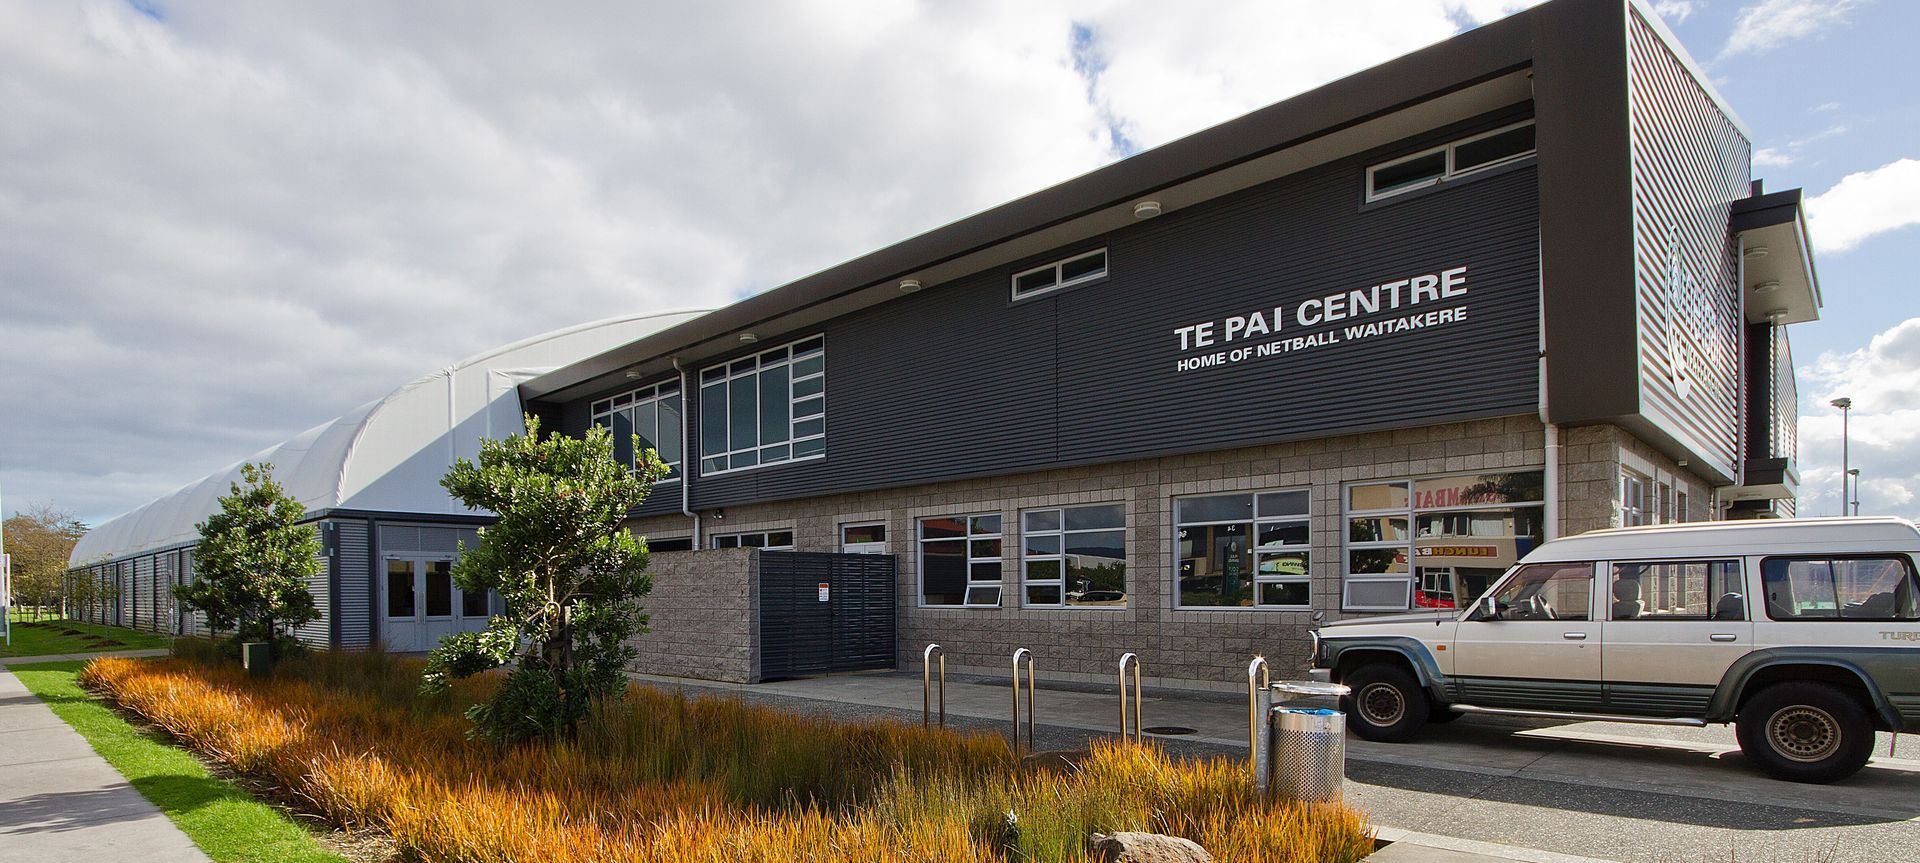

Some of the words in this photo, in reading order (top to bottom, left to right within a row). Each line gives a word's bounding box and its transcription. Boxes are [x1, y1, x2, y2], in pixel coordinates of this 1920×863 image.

[1174, 321, 1214, 350] TE
[1225, 306, 1282, 342] PAI
[1296, 266, 1467, 326] CENTRE
[1177, 352, 1226, 372] HOME
[1229, 346, 1253, 362] OF
[1257, 331, 1340, 357] NETBALL
[1344, 306, 1467, 340] WAITAKERE
